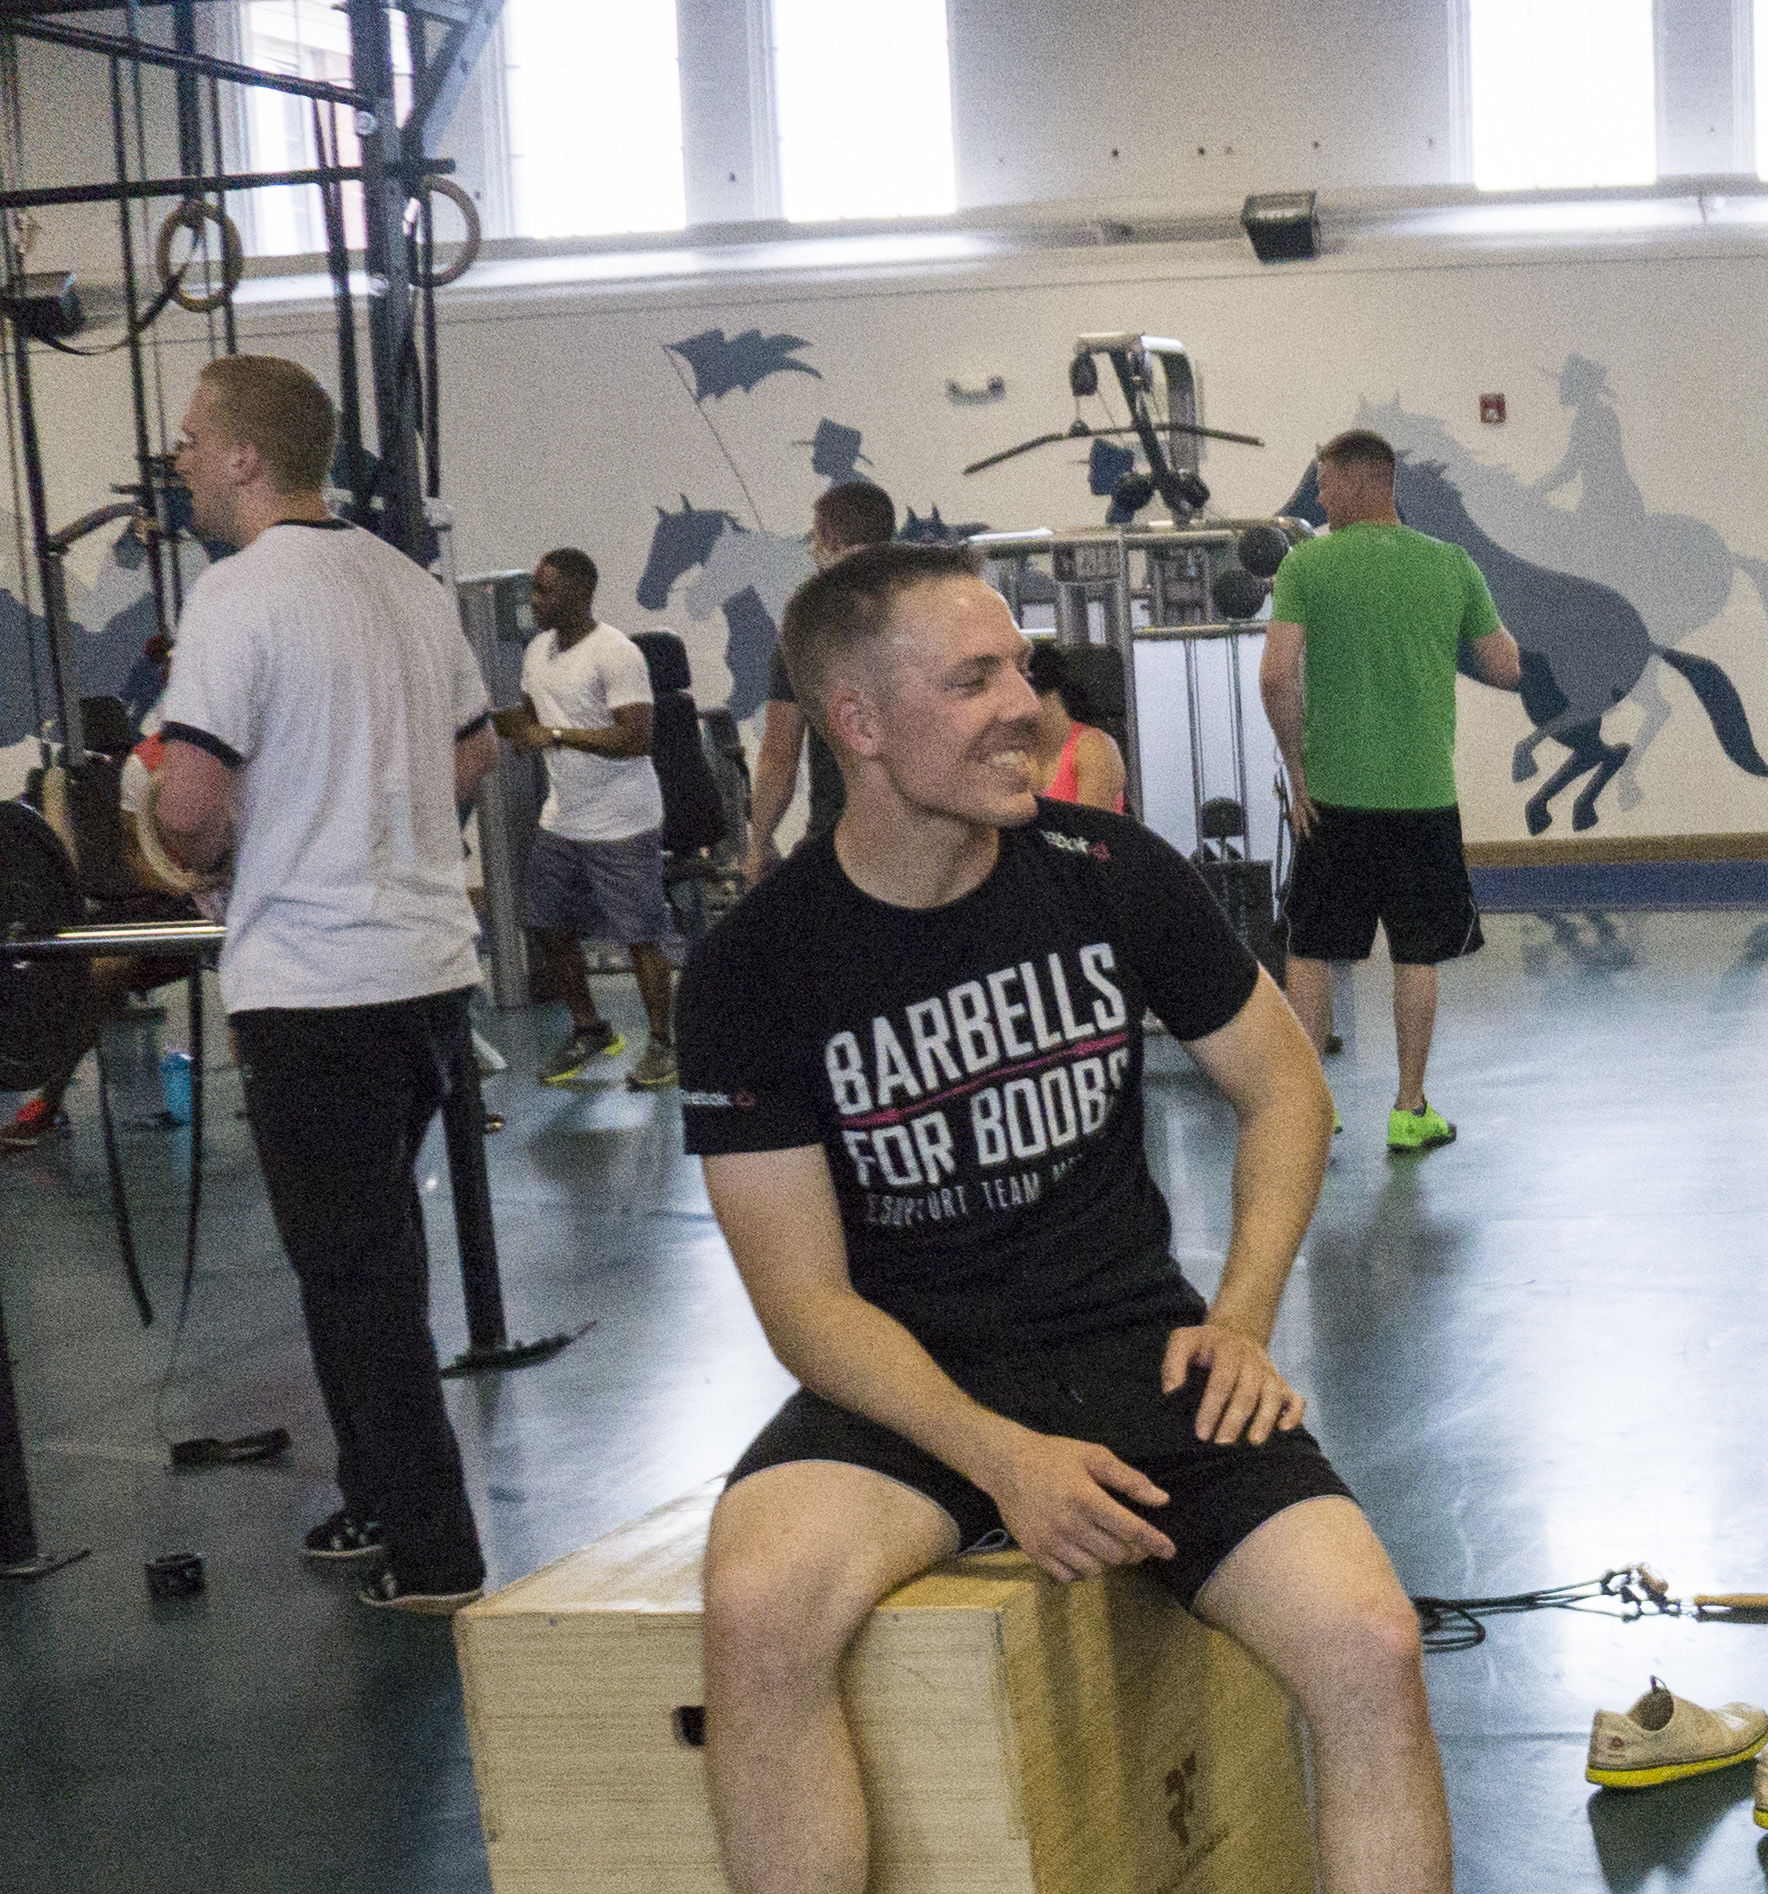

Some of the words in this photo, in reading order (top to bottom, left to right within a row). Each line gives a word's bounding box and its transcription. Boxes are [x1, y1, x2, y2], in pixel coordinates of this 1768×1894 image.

[824, 942, 1127, 1116] BARBELLS
[842, 1110, 956, 1188] FOR
[981, 1171, 1041, 1209] TEAM
